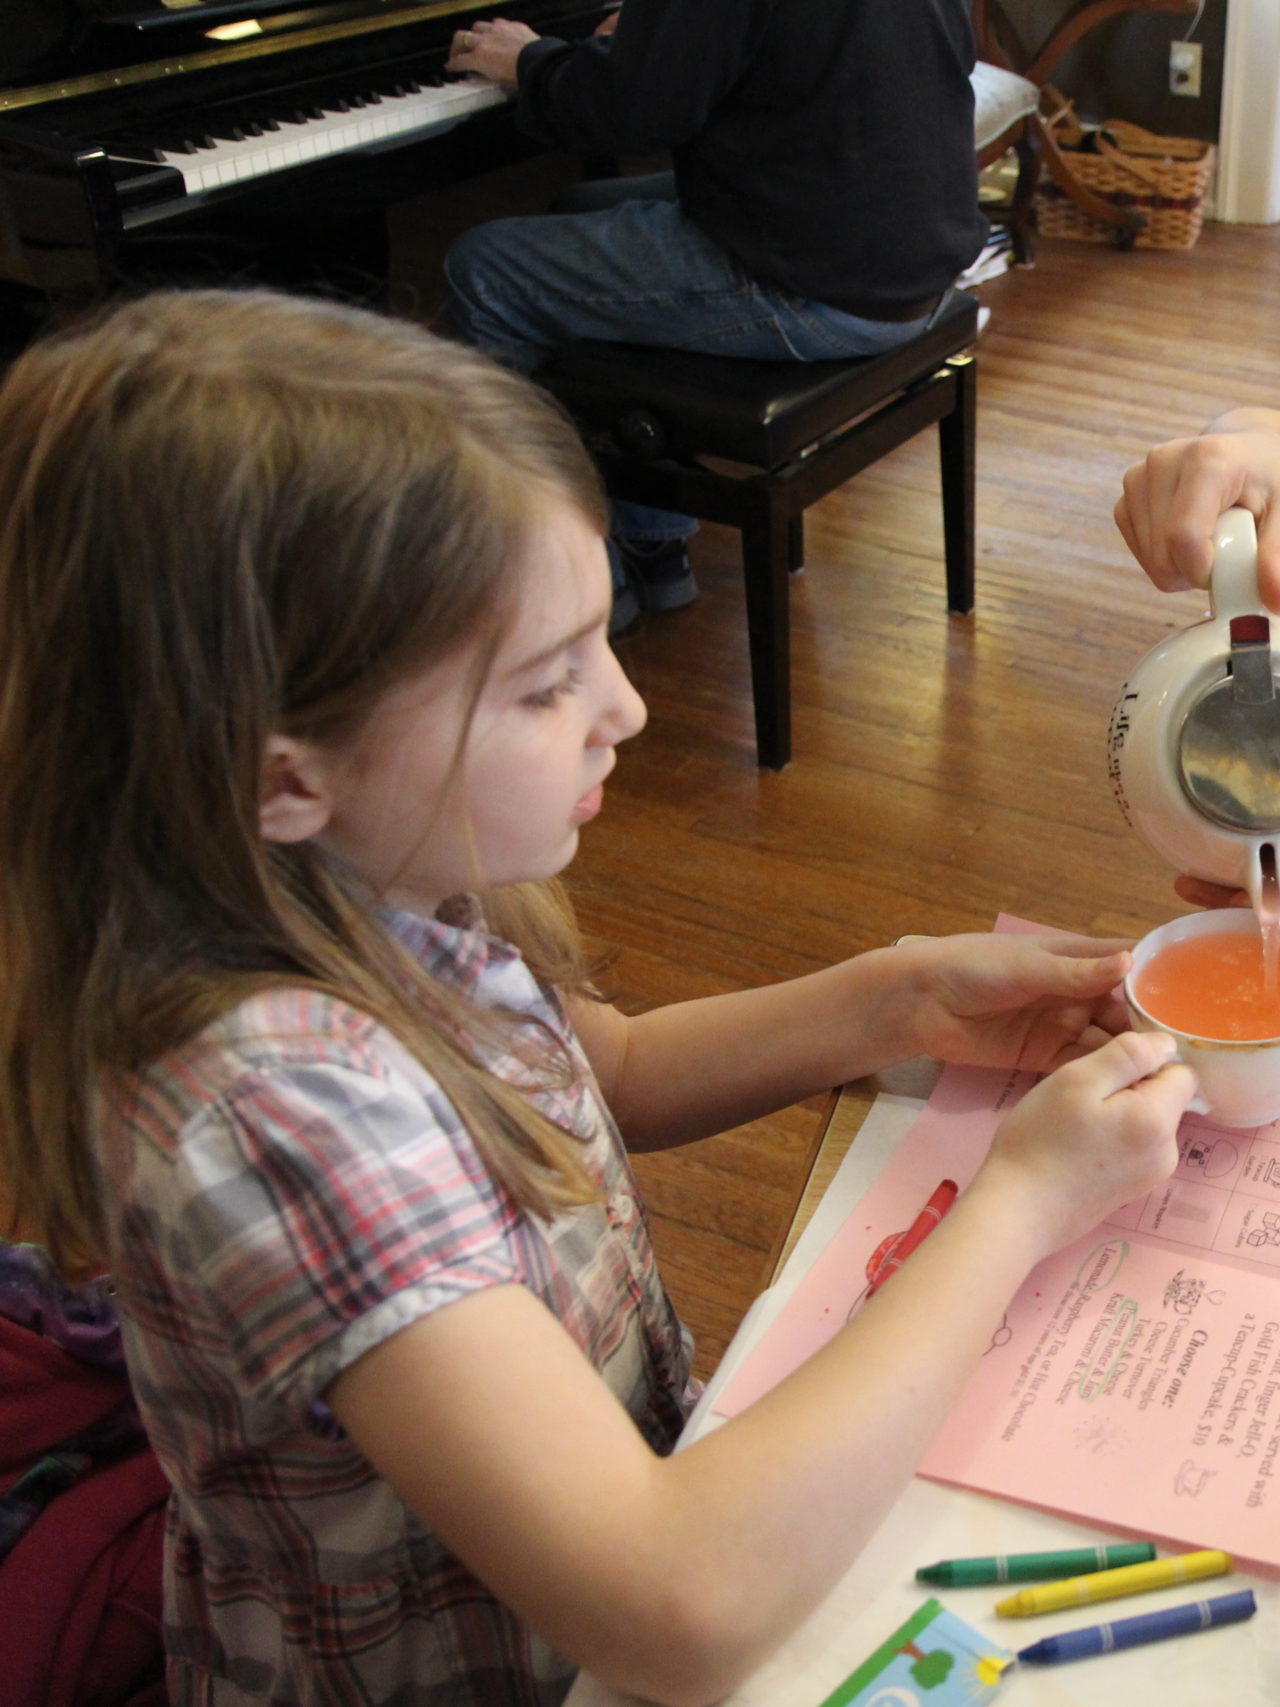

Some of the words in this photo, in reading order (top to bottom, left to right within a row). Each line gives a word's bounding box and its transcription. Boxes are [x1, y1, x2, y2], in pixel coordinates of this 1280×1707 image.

[1056, 1292, 1092, 1336] Raspberry
[1112, 1306, 1136, 1337] Peanut
[1243, 1312, 1256, 1321] a
[1080, 1317, 1112, 1359] Macaroni
[1143, 1320, 1169, 1354] Cheese
[1159, 1317, 1190, 1365] Cucumber
[1256, 1321, 1280, 1351] Gold
[1039, 1359, 1052, 1372] or
[1074, 1358, 1088, 1369] &
[1097, 1337, 1121, 1368] Butter
[1176, 1329, 1208, 1377] Choose
[1245, 1350, 1268, 1377] Fish
[1028, 1371, 1049, 1392] Hot
[1055, 1370, 1082, 1406] Cheese
[1091, 1367, 1105, 1378] &
[1102, 1361, 1129, 1397] Cheese
[1122, 1356, 1152, 1400] Turnover
[1161, 1377, 1183, 1409] one:
[1223, 1378, 1257, 1432] Crackers
[1001, 1391, 1037, 1442] Chocolate
[1191, 1423, 1213, 1447] $10
[1216, 1432, 1235, 1446] &
[1245, 1479, 1266, 1509] with
